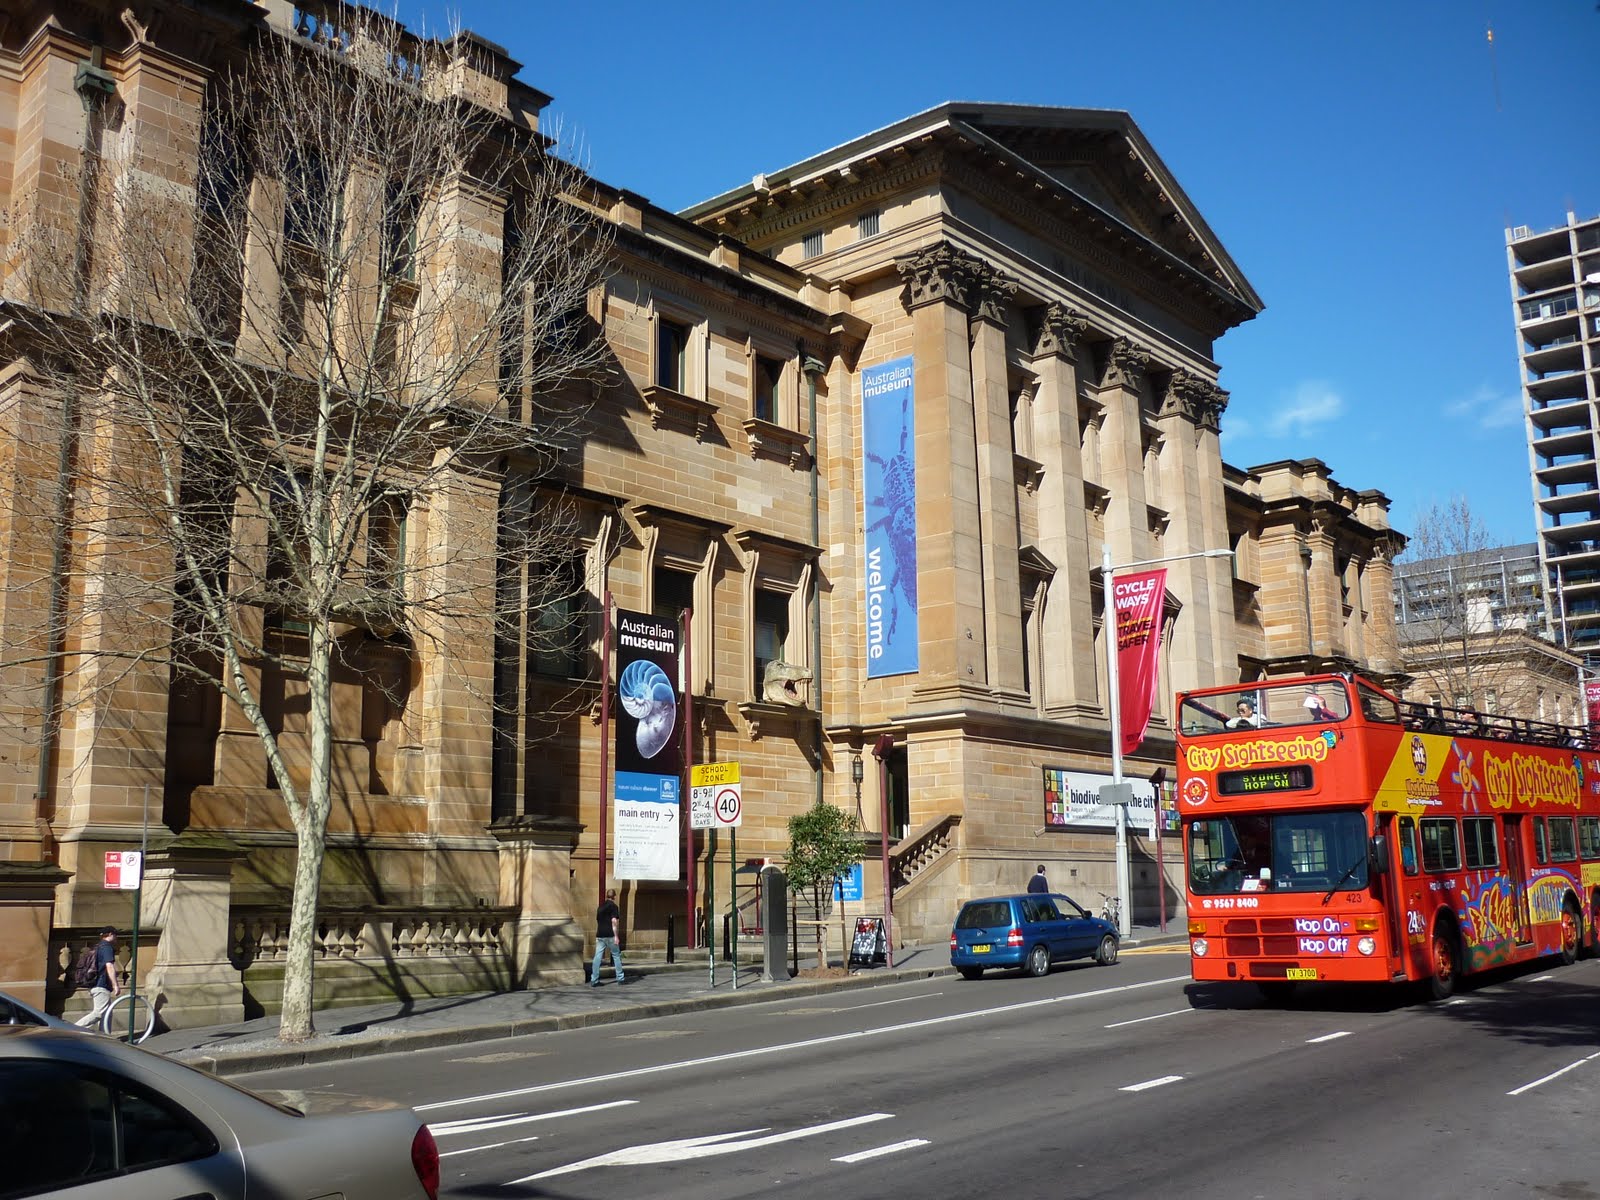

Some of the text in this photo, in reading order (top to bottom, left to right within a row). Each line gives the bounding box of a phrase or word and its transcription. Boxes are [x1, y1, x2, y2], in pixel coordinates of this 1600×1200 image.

[864, 366, 912, 389] Australian
[864, 377, 912, 398] museum
[1116, 579, 1155, 595] CYCLE
[868, 546, 887, 659] welcome
[1116, 593, 1149, 609] WAYS
[1117, 611, 1131, 621] TO
[620, 618, 674, 640] Australian
[1118, 620, 1156, 637] TRAVEL
[620, 634, 675, 653] museum
[1118, 635, 1149, 652] SAFER
[1188, 738, 1326, 769] City Sightseeing
[700, 765, 729, 774] SCHOOL
[1242, 771, 1289, 783] SYDNEY
[704, 774, 725, 783] ZONE
[1244, 779, 1289, 790] HOP ON
[1486, 756, 1579, 806] City Sightseeing
[719, 798, 736, 813] 40
[618, 808, 660, 822] main entry
[1213, 898, 1259, 909] 9567 8400
[1346, 893, 1362, 904] 423
[1295, 918, 1321, 934] Hop
[1322, 917, 1341, 932] On
[1300, 937, 1349, 953] Hop Off
[1287, 967, 1316, 978] TV 3700
